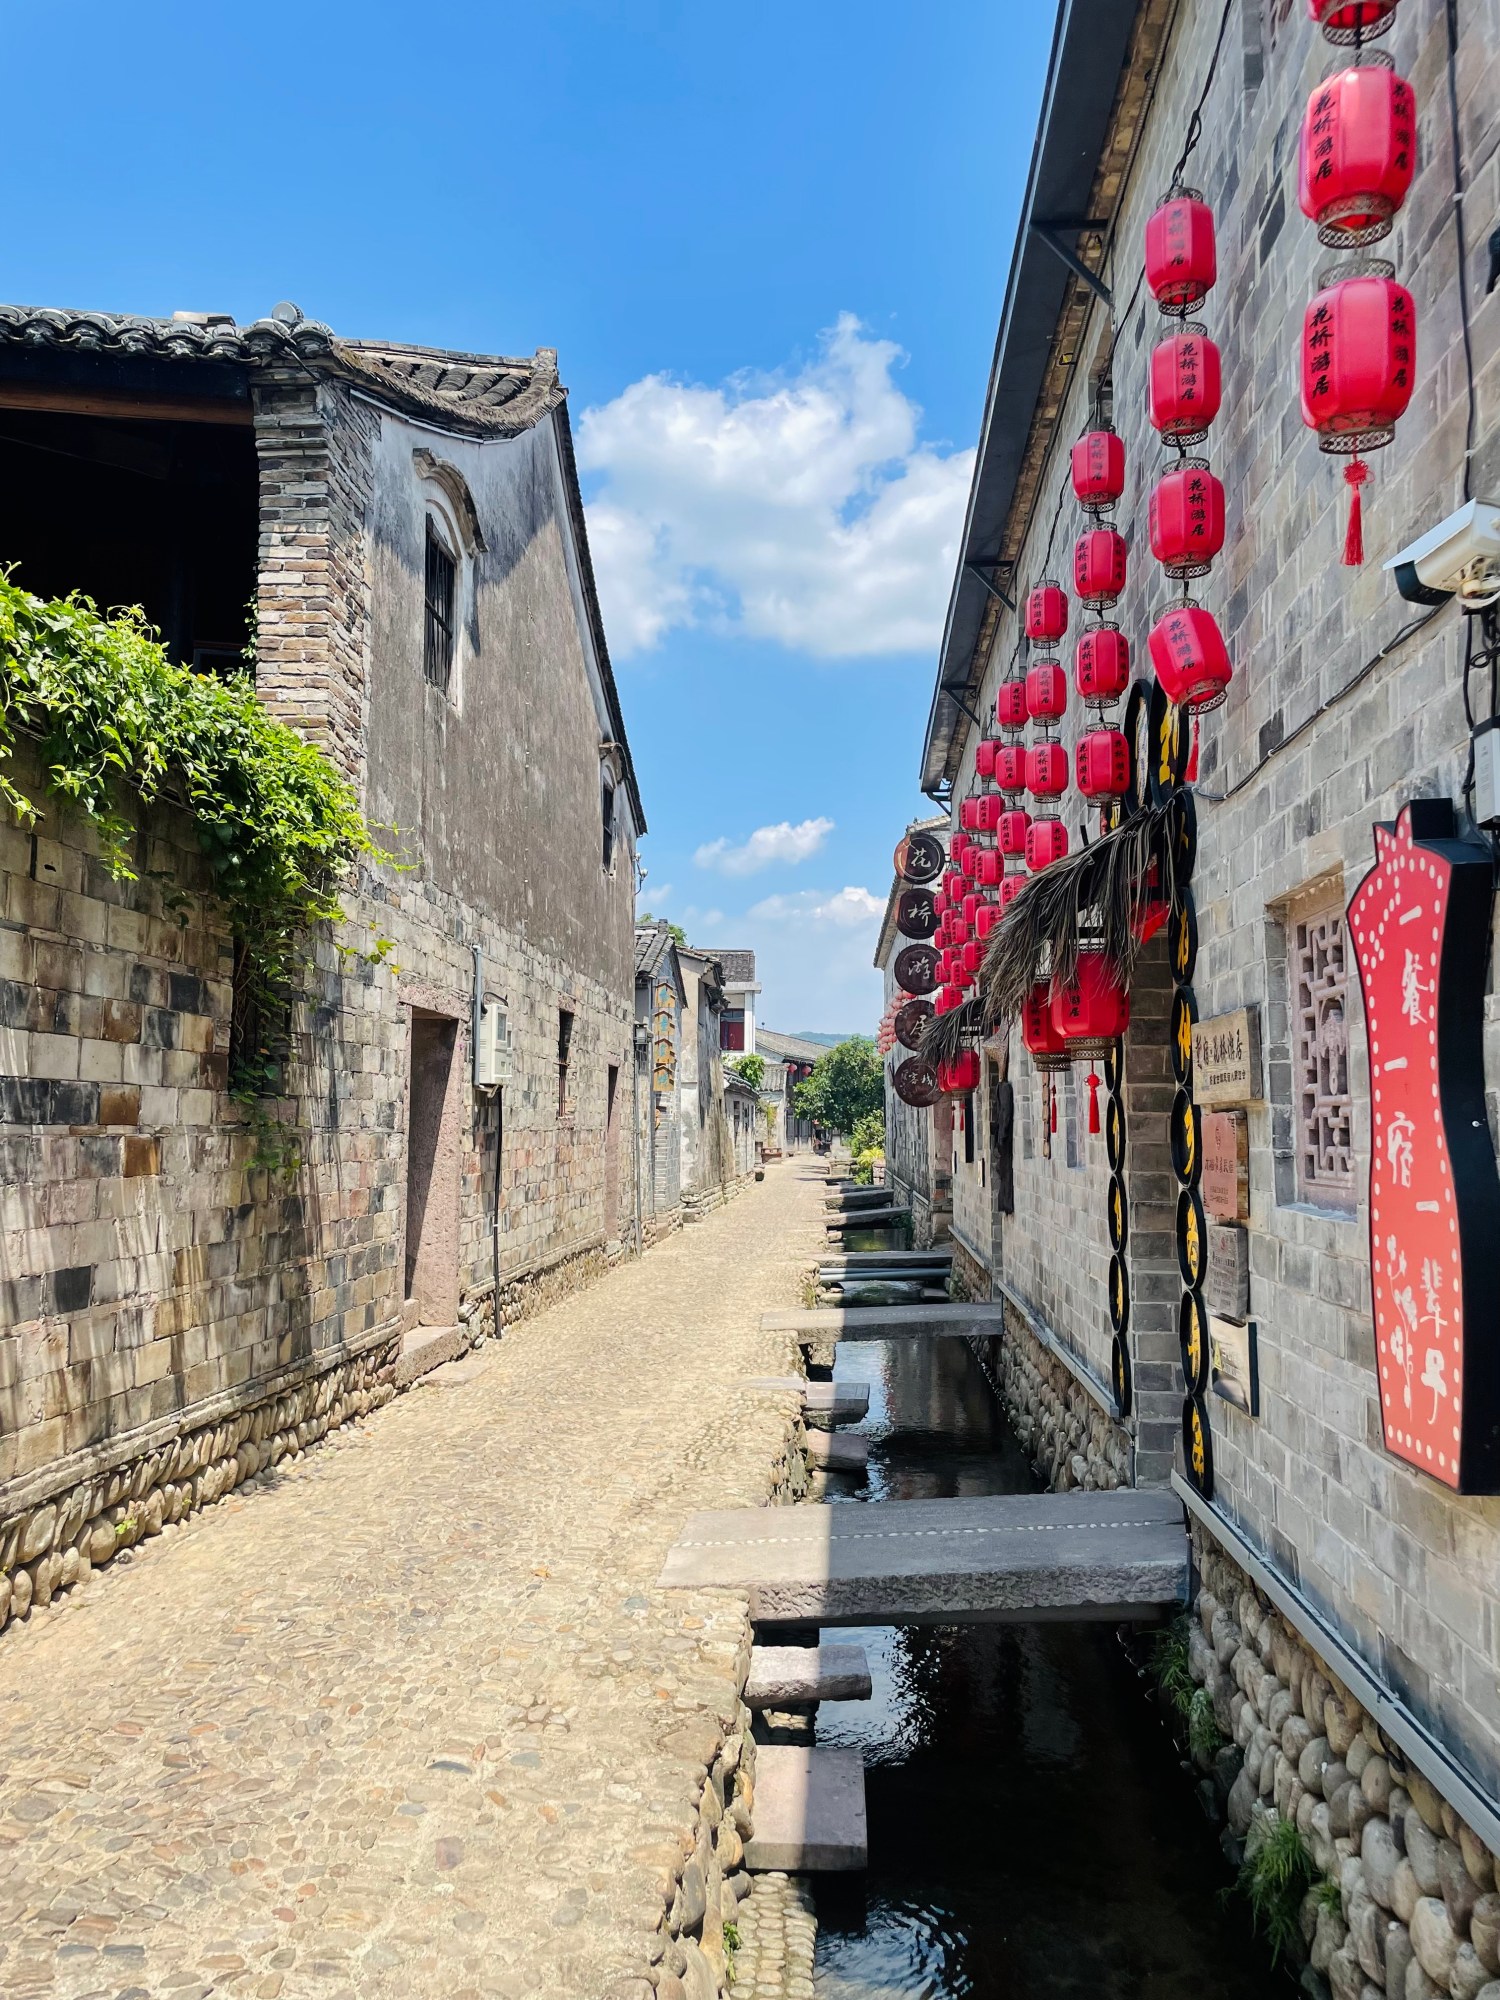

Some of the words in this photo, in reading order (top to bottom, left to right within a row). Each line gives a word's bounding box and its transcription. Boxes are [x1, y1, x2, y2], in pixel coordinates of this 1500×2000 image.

[1313, 90, 1336, 184] 花桥游居
[1180, 342, 1198, 400] 花桥游居
[1310, 303, 1334, 399] 花桥游居
[1188, 478, 1206, 536] 花桥游居
[1077, 540, 1088, 583] 花桥游居
[1082, 640, 1093, 682] 花桥游居
[1169, 618, 1195, 672] 花桥游居
[1384, 905, 1448, 1425] 一餐一宿一辈子
